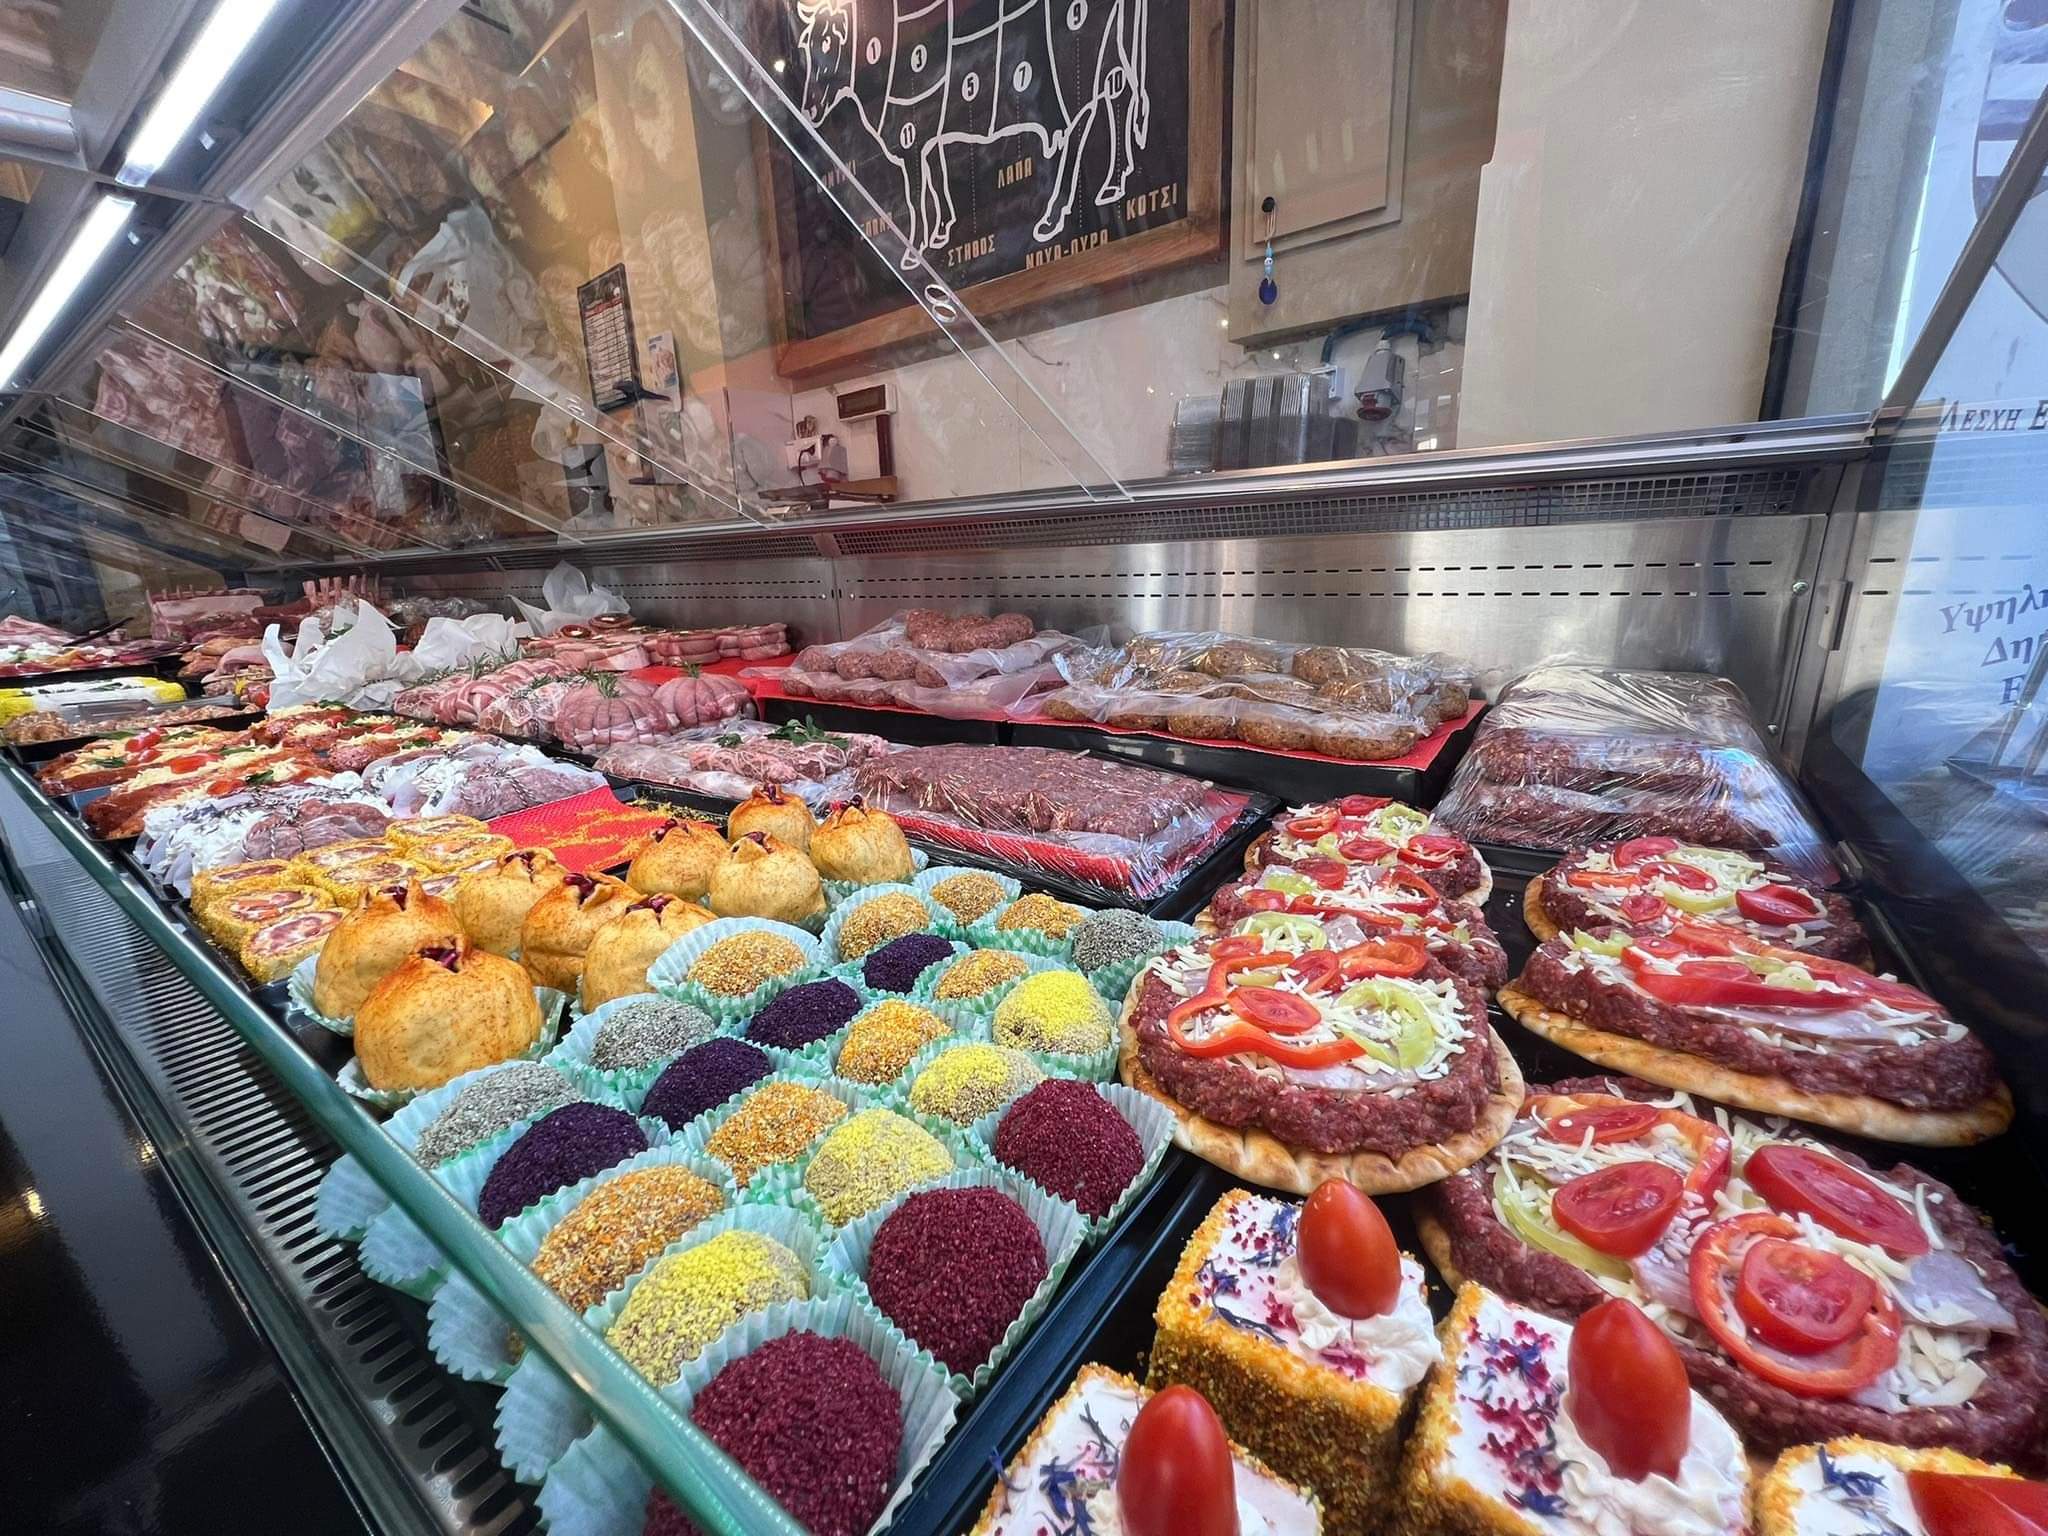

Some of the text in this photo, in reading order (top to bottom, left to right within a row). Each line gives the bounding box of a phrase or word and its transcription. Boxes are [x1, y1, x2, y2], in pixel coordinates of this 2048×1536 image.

[1107, 70, 1123, 94] 10
[998, 157, 1033, 189] ΛΑΠΑ
[1126, 182, 1178, 221] ΚΟΤΣΙ
[948, 234, 996, 266] ΣΤΗΘΟΣ
[1939, 397, 2022, 432] ΛΕΣΧΗ
